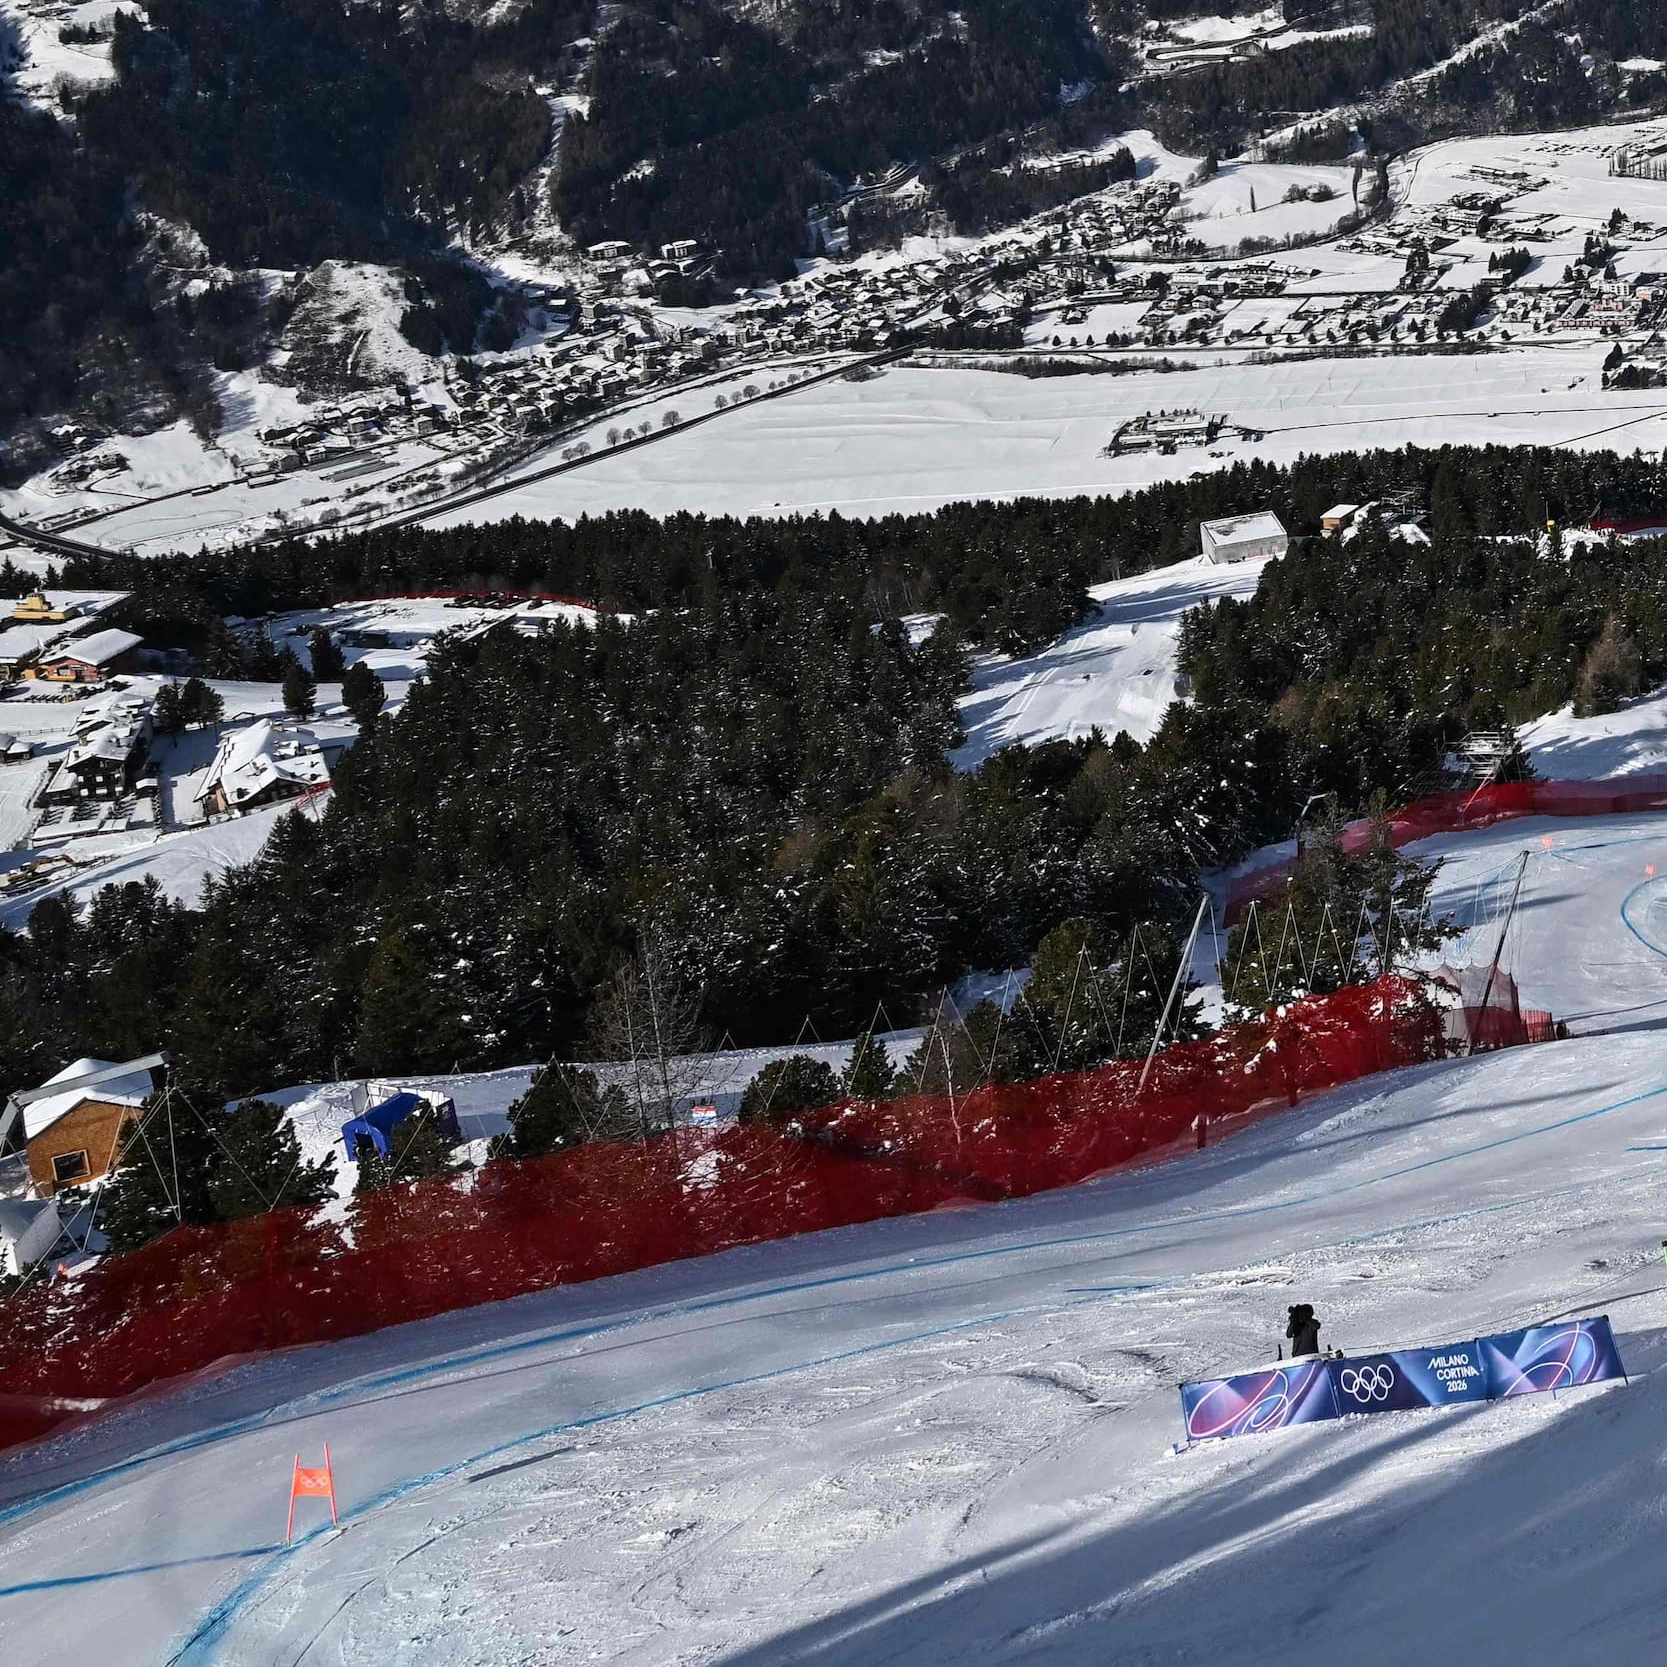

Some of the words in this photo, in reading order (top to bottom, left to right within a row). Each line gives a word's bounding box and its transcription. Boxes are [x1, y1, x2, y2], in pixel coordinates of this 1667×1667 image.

[1427, 1354, 1469, 1370] MILANO
[1436, 1365, 1480, 1380] CORTINA
[1446, 1379, 1468, 1393] 2026
